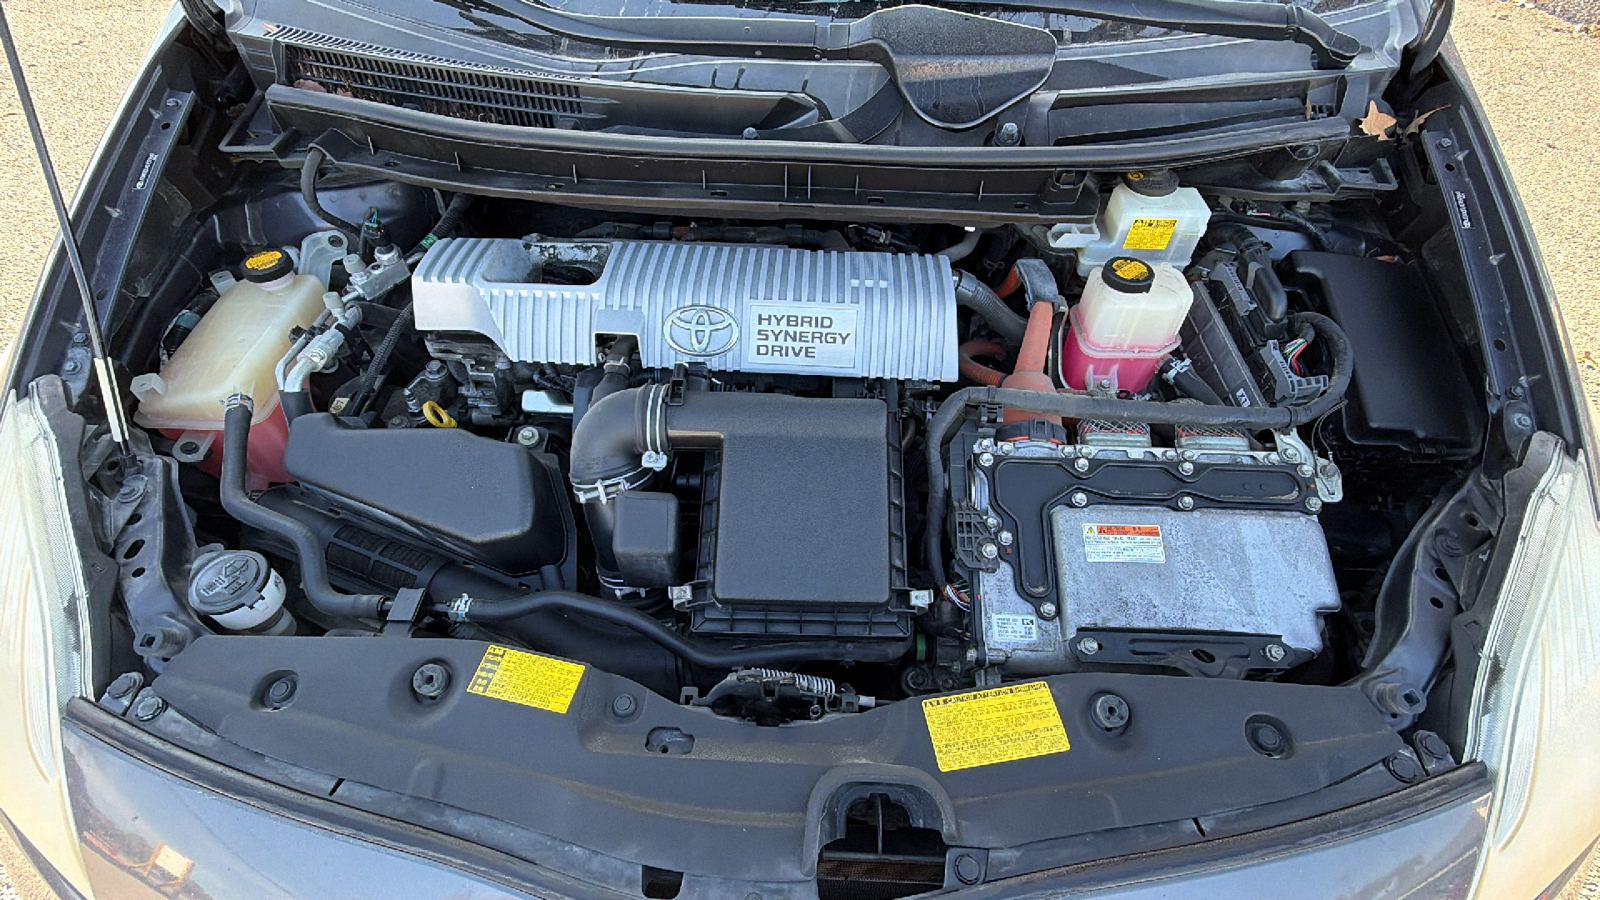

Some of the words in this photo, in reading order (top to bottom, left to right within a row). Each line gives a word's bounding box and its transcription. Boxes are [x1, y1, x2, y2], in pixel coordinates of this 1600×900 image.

[758, 314, 834, 329] HYBRID
[757, 329, 851, 345] SYNERGY
[756, 344, 816, 358] DRIVE
